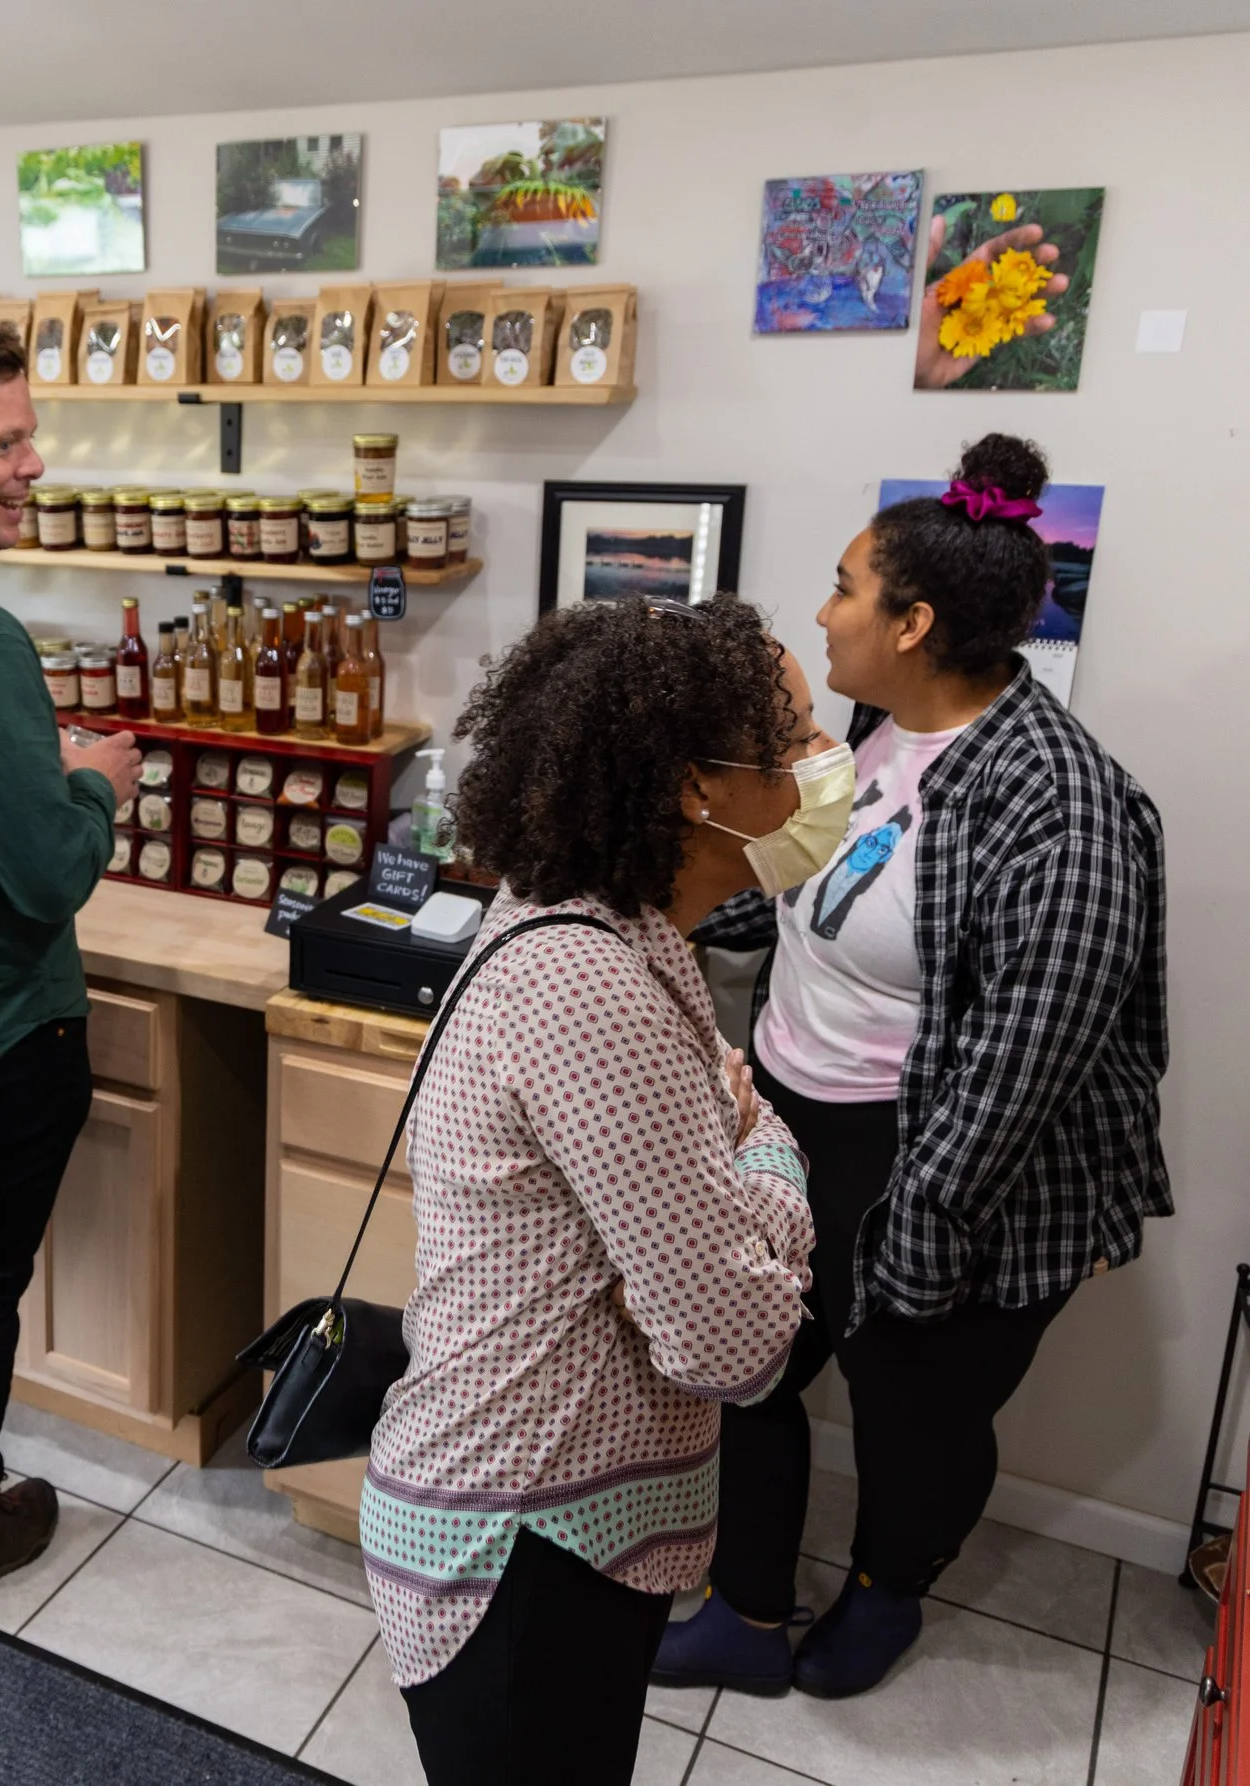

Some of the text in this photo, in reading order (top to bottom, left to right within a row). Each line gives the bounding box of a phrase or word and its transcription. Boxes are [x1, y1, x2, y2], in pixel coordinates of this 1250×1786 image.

[377, 850, 396, 866] We
[396, 853, 430, 872] have
[381, 867, 416, 884] GIFT
[376, 883, 428, 902] CARDS!
